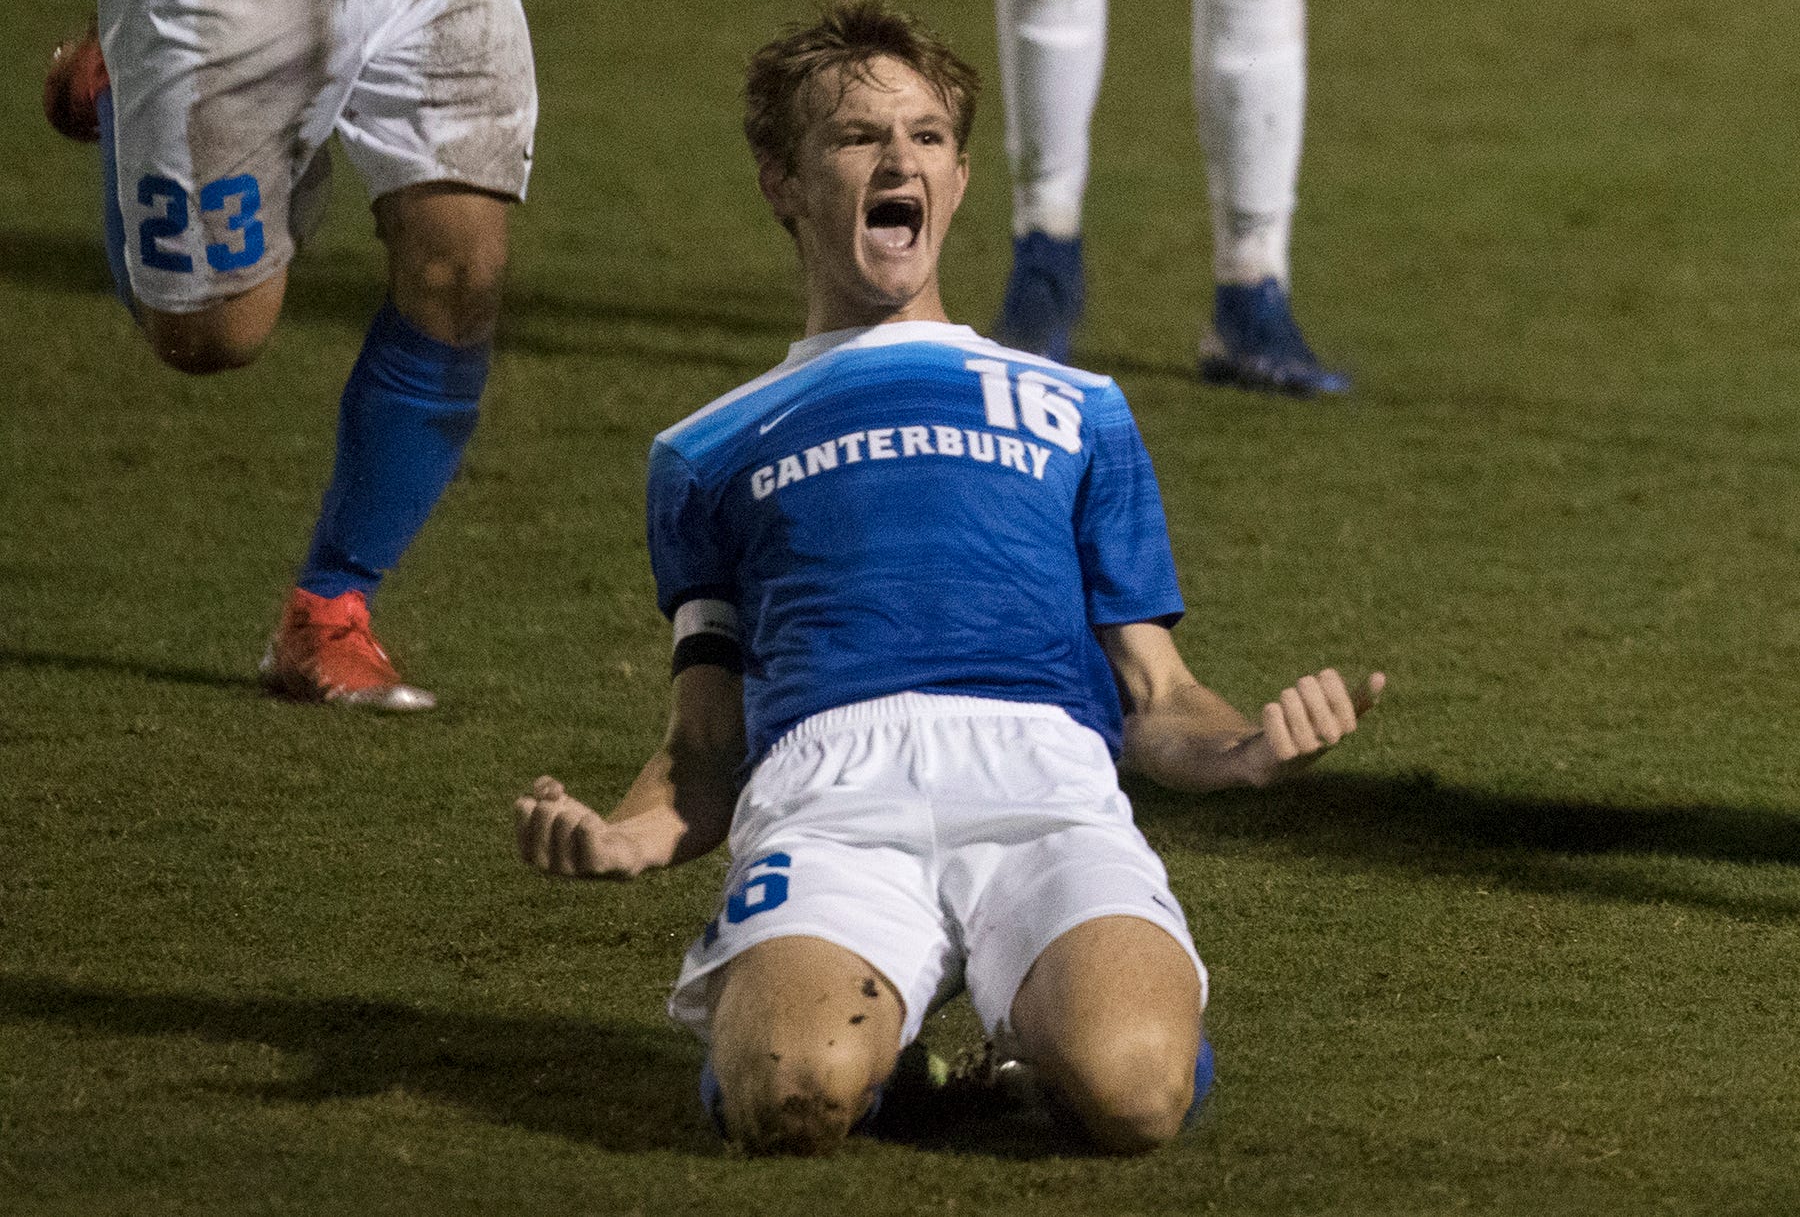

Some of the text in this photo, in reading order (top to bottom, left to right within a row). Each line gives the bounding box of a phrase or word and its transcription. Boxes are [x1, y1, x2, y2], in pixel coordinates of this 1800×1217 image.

[137, 173, 265, 273] 23
[965, 357, 1085, 455] 16
[750, 424, 1052, 501] CANTERBURY
